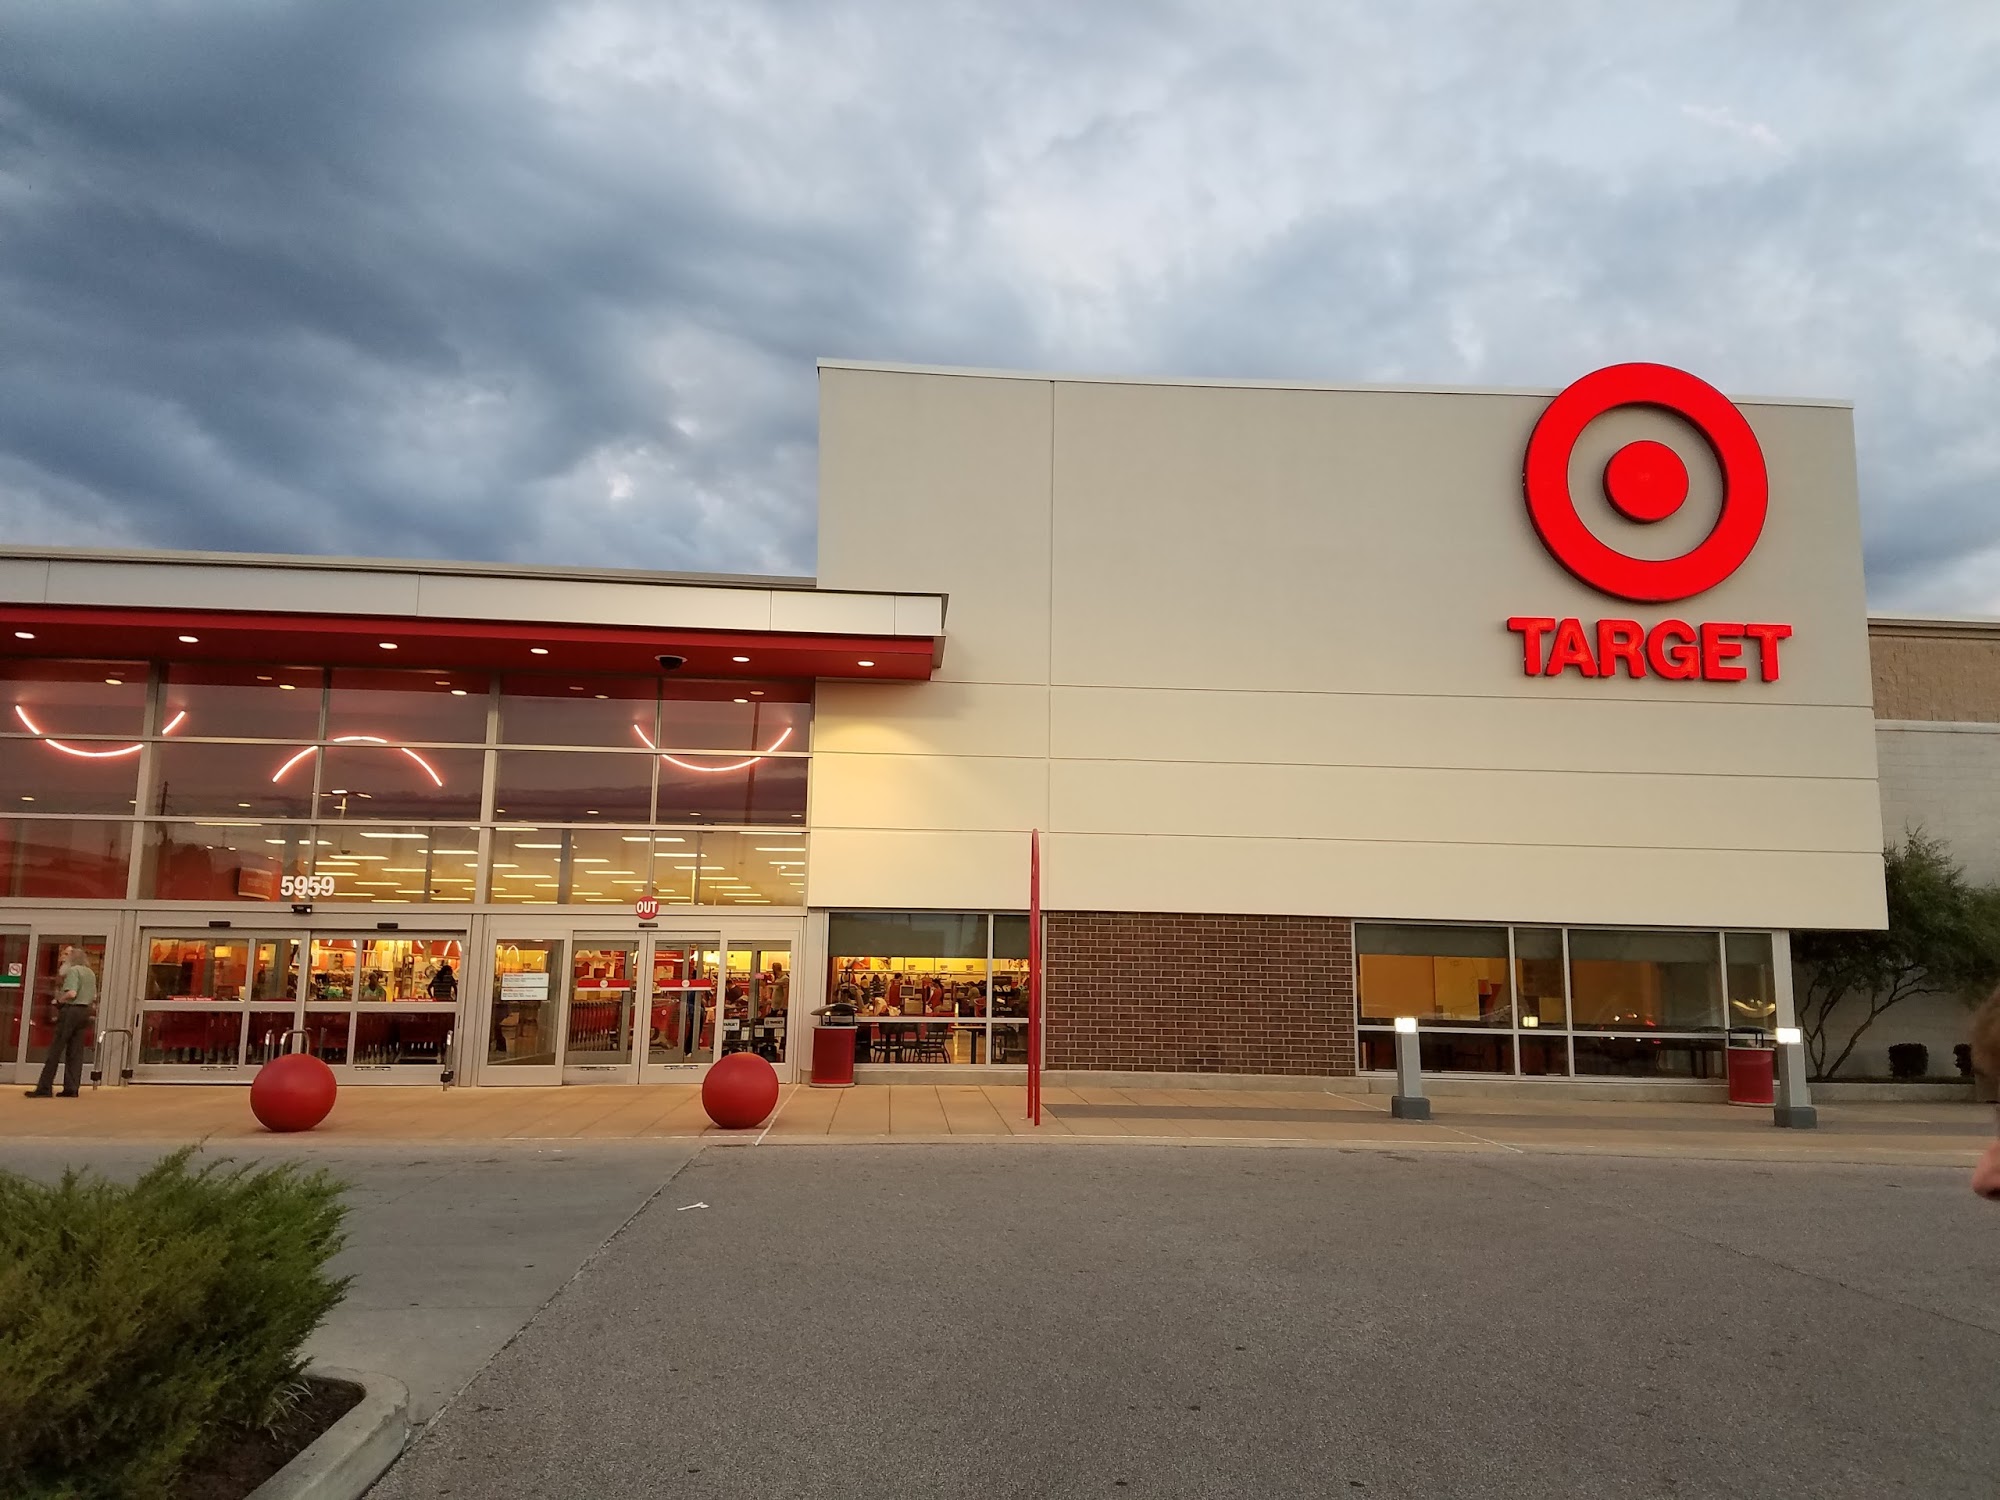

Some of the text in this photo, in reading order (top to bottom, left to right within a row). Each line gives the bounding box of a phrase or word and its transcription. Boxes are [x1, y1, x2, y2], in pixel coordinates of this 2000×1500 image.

[1506, 616, 1792, 681] TARGET
[280, 876, 335, 896] 5959
[636, 900, 658, 914] OUT
